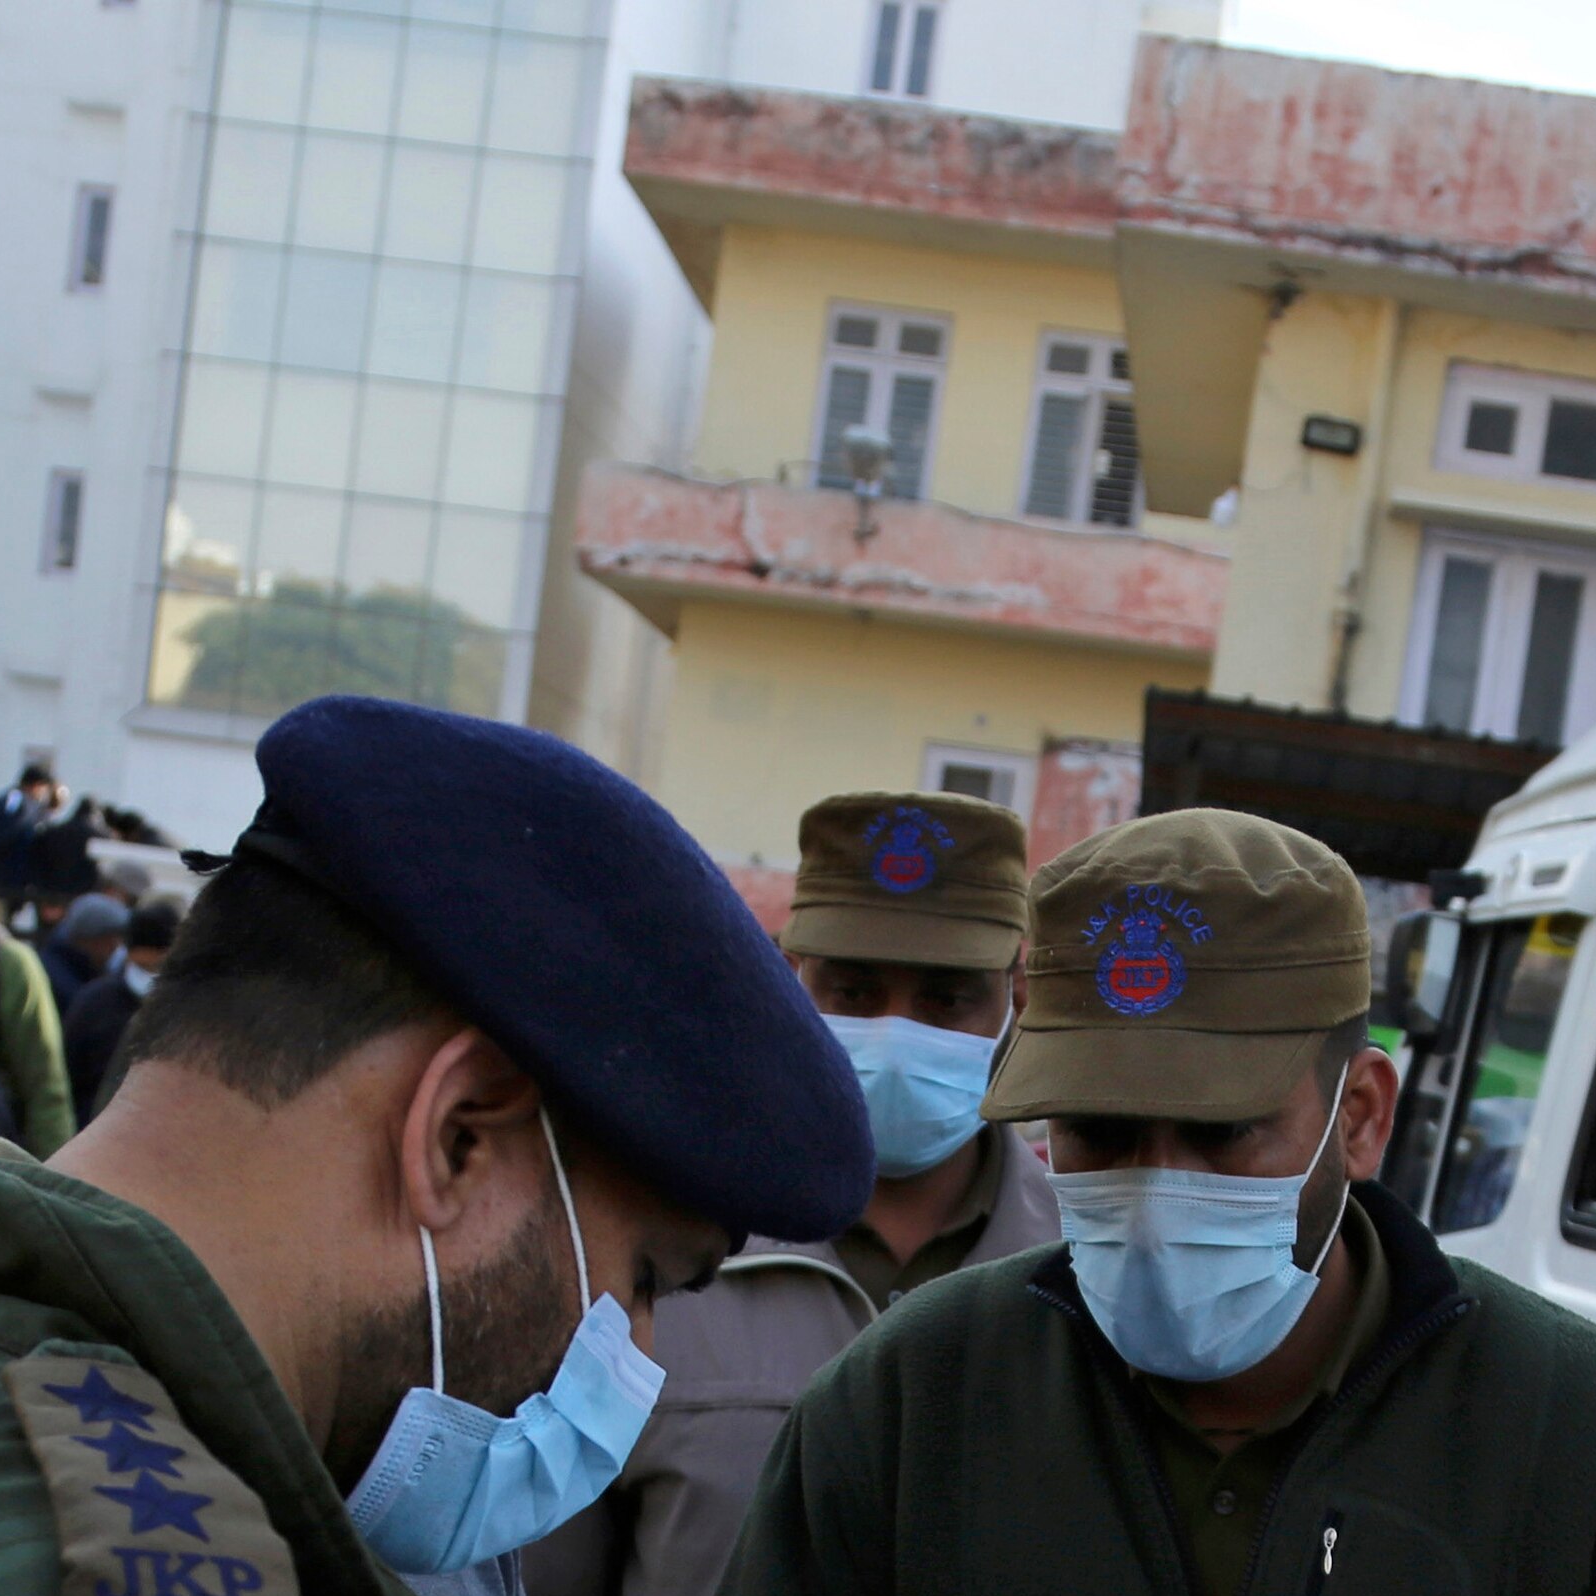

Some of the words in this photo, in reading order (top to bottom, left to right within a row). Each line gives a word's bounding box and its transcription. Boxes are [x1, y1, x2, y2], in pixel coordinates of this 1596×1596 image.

[1081, 902, 1120, 945] J&K
[1127, 884, 1214, 945] POLICE
[1118, 966, 1166, 988] JKP
